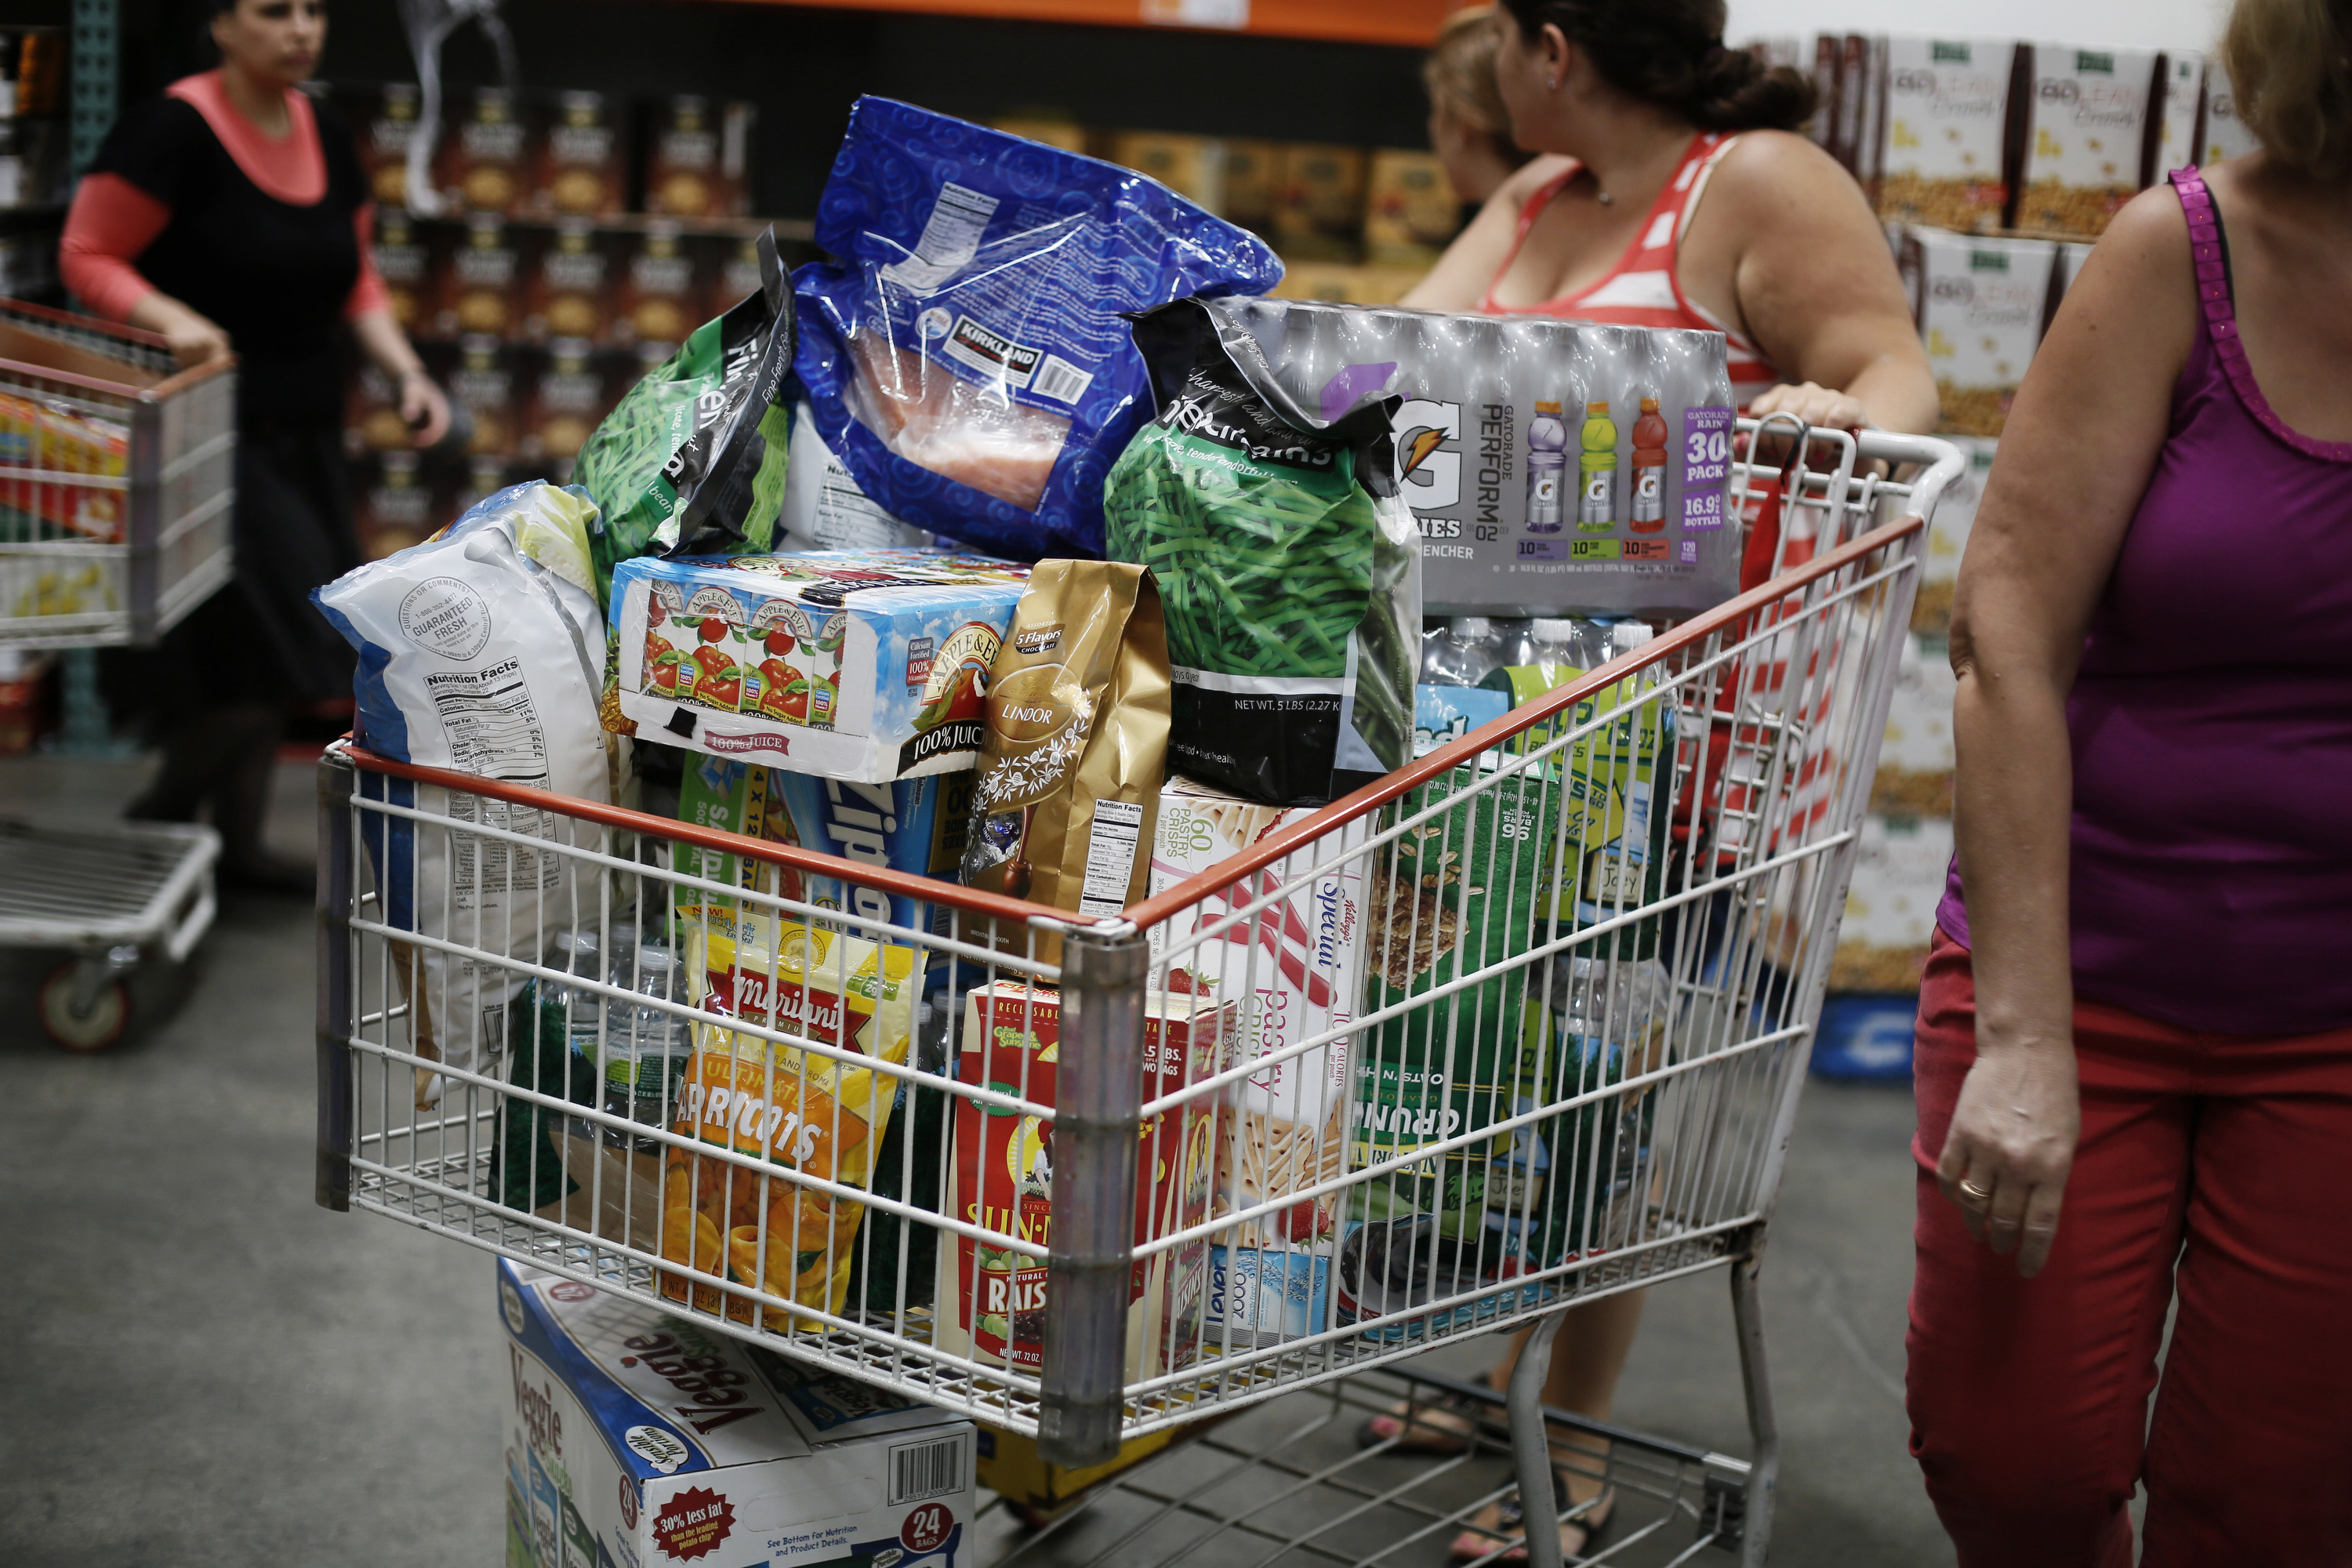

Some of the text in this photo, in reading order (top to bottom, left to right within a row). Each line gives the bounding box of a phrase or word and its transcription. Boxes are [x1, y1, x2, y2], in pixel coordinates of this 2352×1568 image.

[961, 323, 1035, 365] KIRKLAND
[1697, 419, 1723, 429] RAIN
[1391, 398, 1462, 510] G
[1502, 405, 1514, 481] GATORADE
[1687, 430, 1726, 463] 30
[1478, 404, 1504, 524] PERFORM
[1688, 465, 1724, 481] PACK
[1536, 478, 1555, 501] G
[1588, 478, 1606, 501] G
[1639, 474, 1657, 498] G
[650, 485, 673, 514] bean
[1686, 495, 1715, 516] 16.9
[1685, 516, 1721, 527] BOTTLES
[1475, 525, 1498, 542] 02
[1520, 542, 1534, 554] 10
[1573, 542, 1588, 554] 10
[1624, 542, 1639, 554] 10
[403, 579, 470, 629] QUESTIONS OR COMMENTS?
[415, 592, 457, 619] 1-800-352-4477
[692, 592, 739, 621] APPLE & EVE
[412, 597, 473, 637] GUARANTEED
[434, 616, 468, 640] FRESH
[757, 604, 807, 633] APPLE & EVE
[1025, 619, 1056, 629] ASSORTED
[467, 638, 485, 657] 4:30pm
[910, 641, 931, 650] Calcium
[1015, 629, 1062, 646] 5 Flavors
[909, 660, 929, 673] 100%
[910, 650, 930, 660] Fortified
[934, 633, 974, 693] APPLE
[973, 633, 984, 654] &
[427, 661, 518, 687] Nutrition Facts
[430, 683, 450, 691] Serving
[501, 670, 517, 680] chips)
[659, 685, 673, 696] Added
[439, 704, 464, 713] Calories
[520, 709, 533, 718] 11%
[706, 695, 719, 708] Sugar
[718, 701, 735, 712] Added
[1002, 703, 1053, 724] LINDOR
[1235, 700, 1330, 713] NET WT. 5 LBS (2.27
[773, 708, 786, 720] Sugar
[786, 714, 803, 725] Added
[453, 724, 477, 733] Saturated
[712, 736, 782, 750] 100% JUICE
[914, 726, 952, 760] 100%
[750, 771, 764, 804] 4 X
[915, 777, 927, 806] Johnson
[696, 801, 706, 824] 500
[904, 802, 913, 829] Company
[1098, 800, 1142, 813] Nutrition Facts
[1166, 808, 1181, 858] CRISPS
[1178, 808, 1192, 860] PASTRY
[1189, 818, 1214, 852] 60
[825, 778, 898, 945] Zipoc
[1316, 883, 1346, 970] Special
[1339, 899, 1357, 943] Kellogg's
[732, 975, 843, 1030] Mrini
[999, 1002, 1058, 1020] RECLSABL
[1029, 1031, 1037, 1042] &
[1249, 988, 1288, 1098] pasry
[781, 1058, 800, 1071] AND
[1335, 1047, 1346, 1087] CALORIES
[668, 1282, 705, 1305] WT OZ
[1232, 1272, 1247, 1319] 2000
[1012, 1349, 1041, 1363] WT. 72 OZ.
[620, 1333, 764, 1436] Veggie
[510, 1340, 562, 1460] Veggie
[629, 1435, 675, 1465] Sensible
[642, 1427, 686, 1457] Portions
[622, 1479, 633, 1514] 24
[660, 1501, 724, 1534] 30% less fat
[913, 1508, 941, 1539] 24
[671, 1520, 719, 1543] than the leading
[767, 1526, 858, 1549] See Bottom for Nutrition
[916, 1536, 938, 1548] BAGS
[678, 1537, 698, 1551] potato
[775, 1537, 849, 1558] and Product Details.
